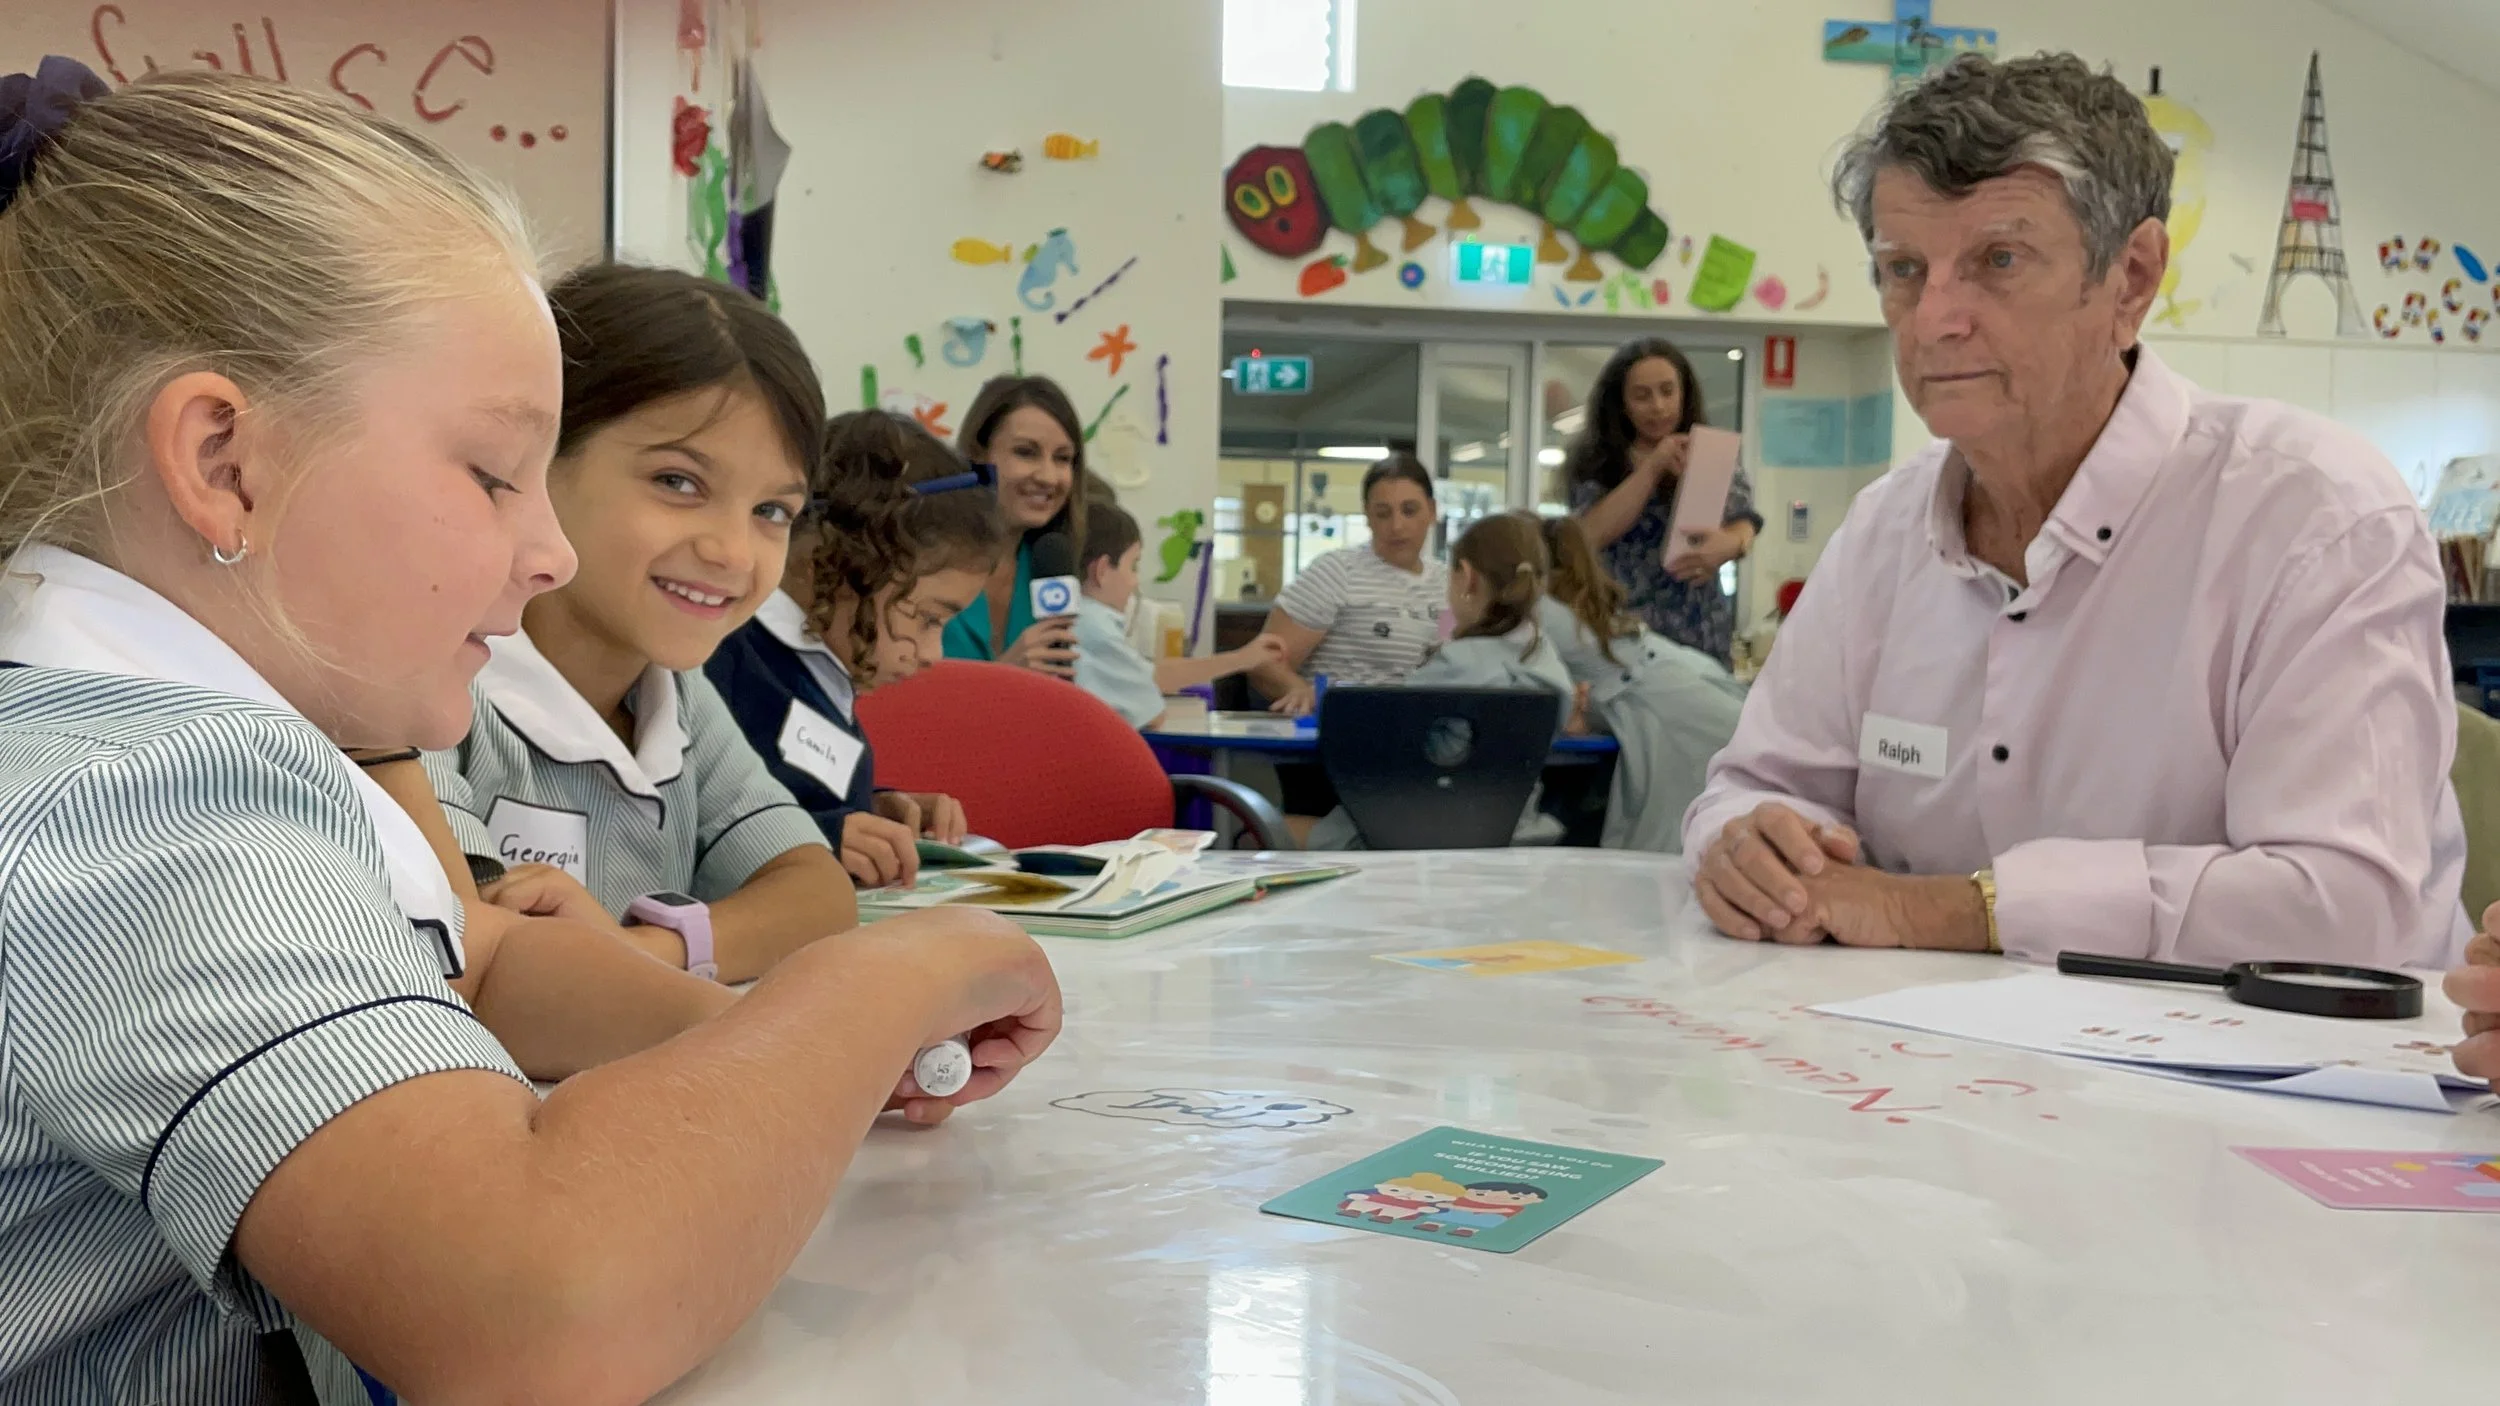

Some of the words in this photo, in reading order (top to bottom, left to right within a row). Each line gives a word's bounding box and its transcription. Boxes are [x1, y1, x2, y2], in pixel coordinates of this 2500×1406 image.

[796, 725, 836, 766] Camila
[1878, 738, 1921, 766] Ralph
[499, 833, 579, 870] Georgia
[1451, 1139, 1497, 1150] WHAT
[1500, 1147, 1554, 1159] WOULD
[1558, 1155, 1588, 1164] YOU
[1489, 1154, 1526, 1164] YOU
[1528, 1161, 1571, 1171] SAW
[1433, 1152, 1525, 1172] SOMEONE
[1525, 1168, 1583, 1180] BEING
[1453, 1163, 1540, 1180] BULLIED?
